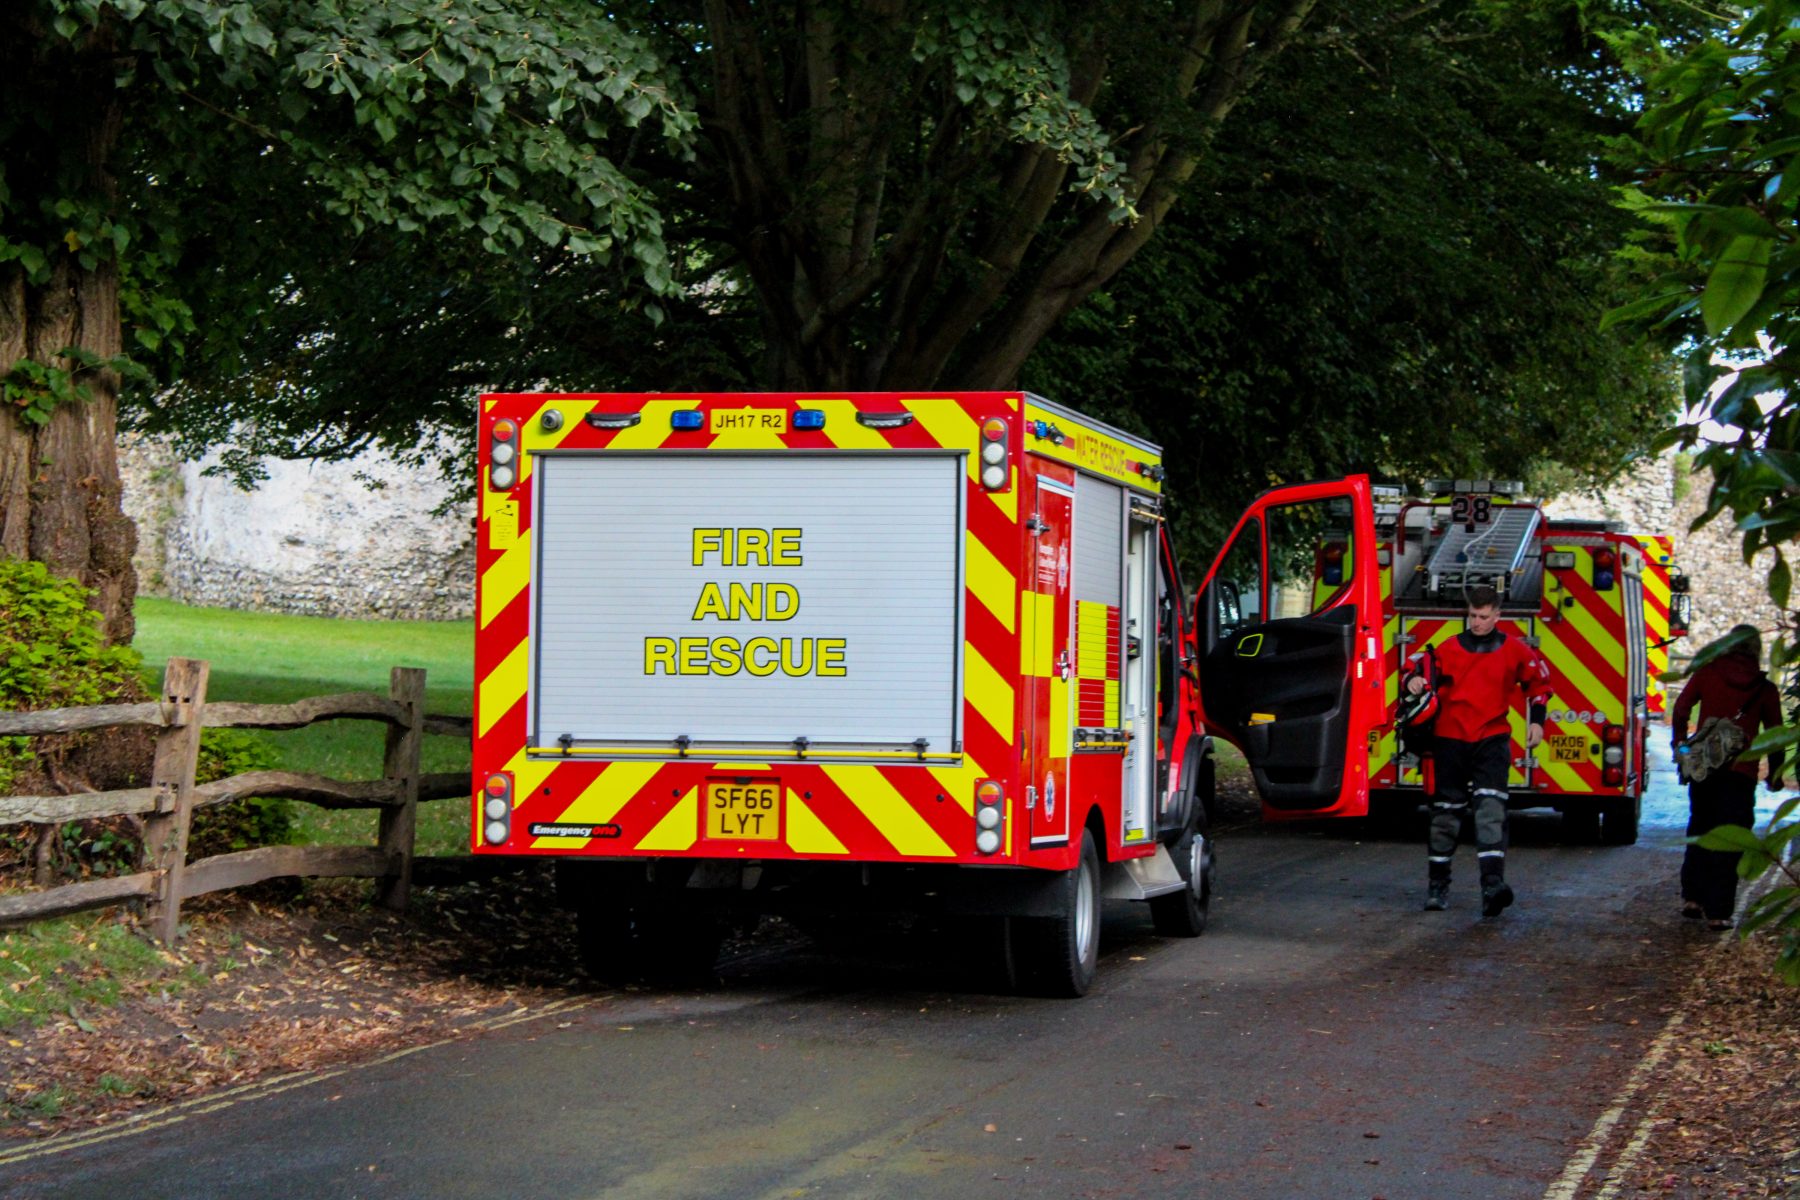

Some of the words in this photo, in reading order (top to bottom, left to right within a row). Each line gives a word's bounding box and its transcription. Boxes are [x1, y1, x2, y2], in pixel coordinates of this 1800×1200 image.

[716, 414, 755, 428] JH17
[761, 414, 782, 428] R2
[1100, 441, 1125, 477] RESCUE
[1452, 497, 1490, 522] 28
[692, 527, 803, 566] FIRE
[691, 582, 800, 621] AND
[644, 636, 847, 677] RESCUE
[715, 788, 773, 809] SF66
[532, 824, 592, 837] Emergency
[721, 813, 765, 834] LYT
